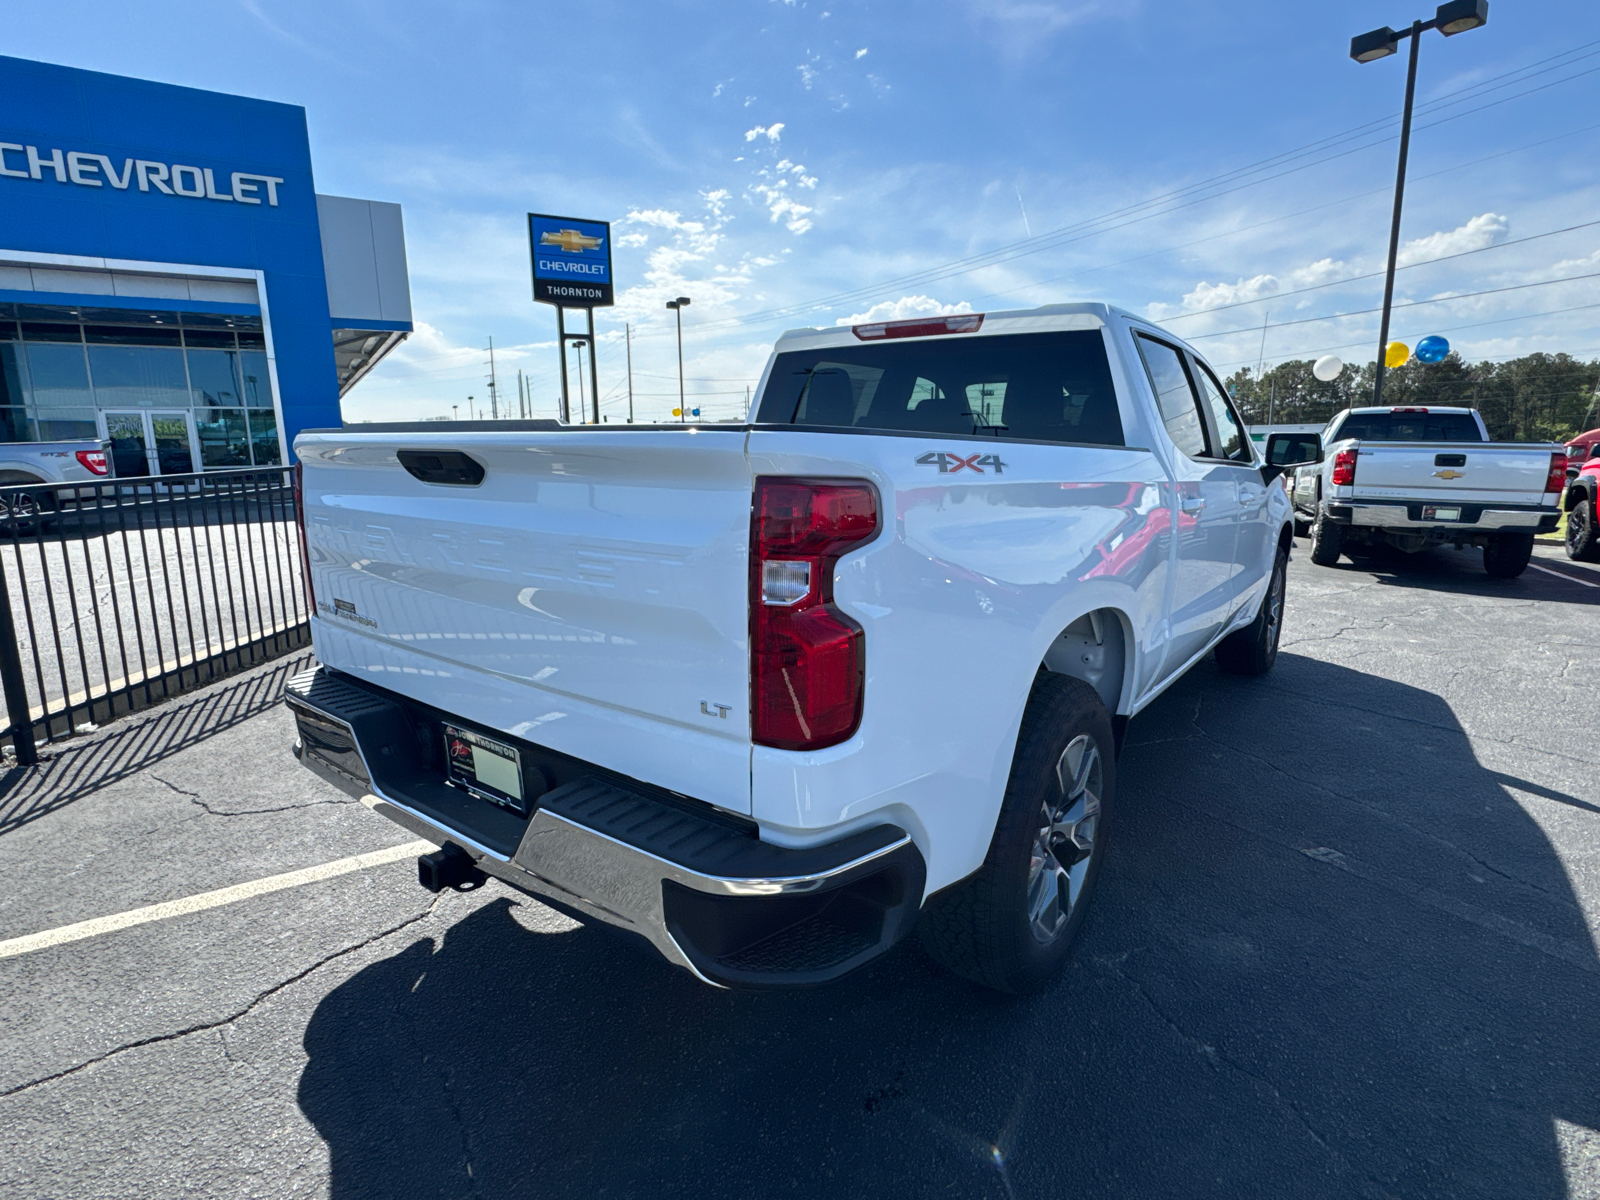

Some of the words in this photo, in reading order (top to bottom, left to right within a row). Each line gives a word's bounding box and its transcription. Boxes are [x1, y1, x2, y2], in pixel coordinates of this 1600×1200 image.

[0, 142, 284, 206] CHEVROLET
[540, 260, 605, 274] CHEVROLET
[547, 286, 602, 297] THORNTON
[700, 700, 732, 719] LT
